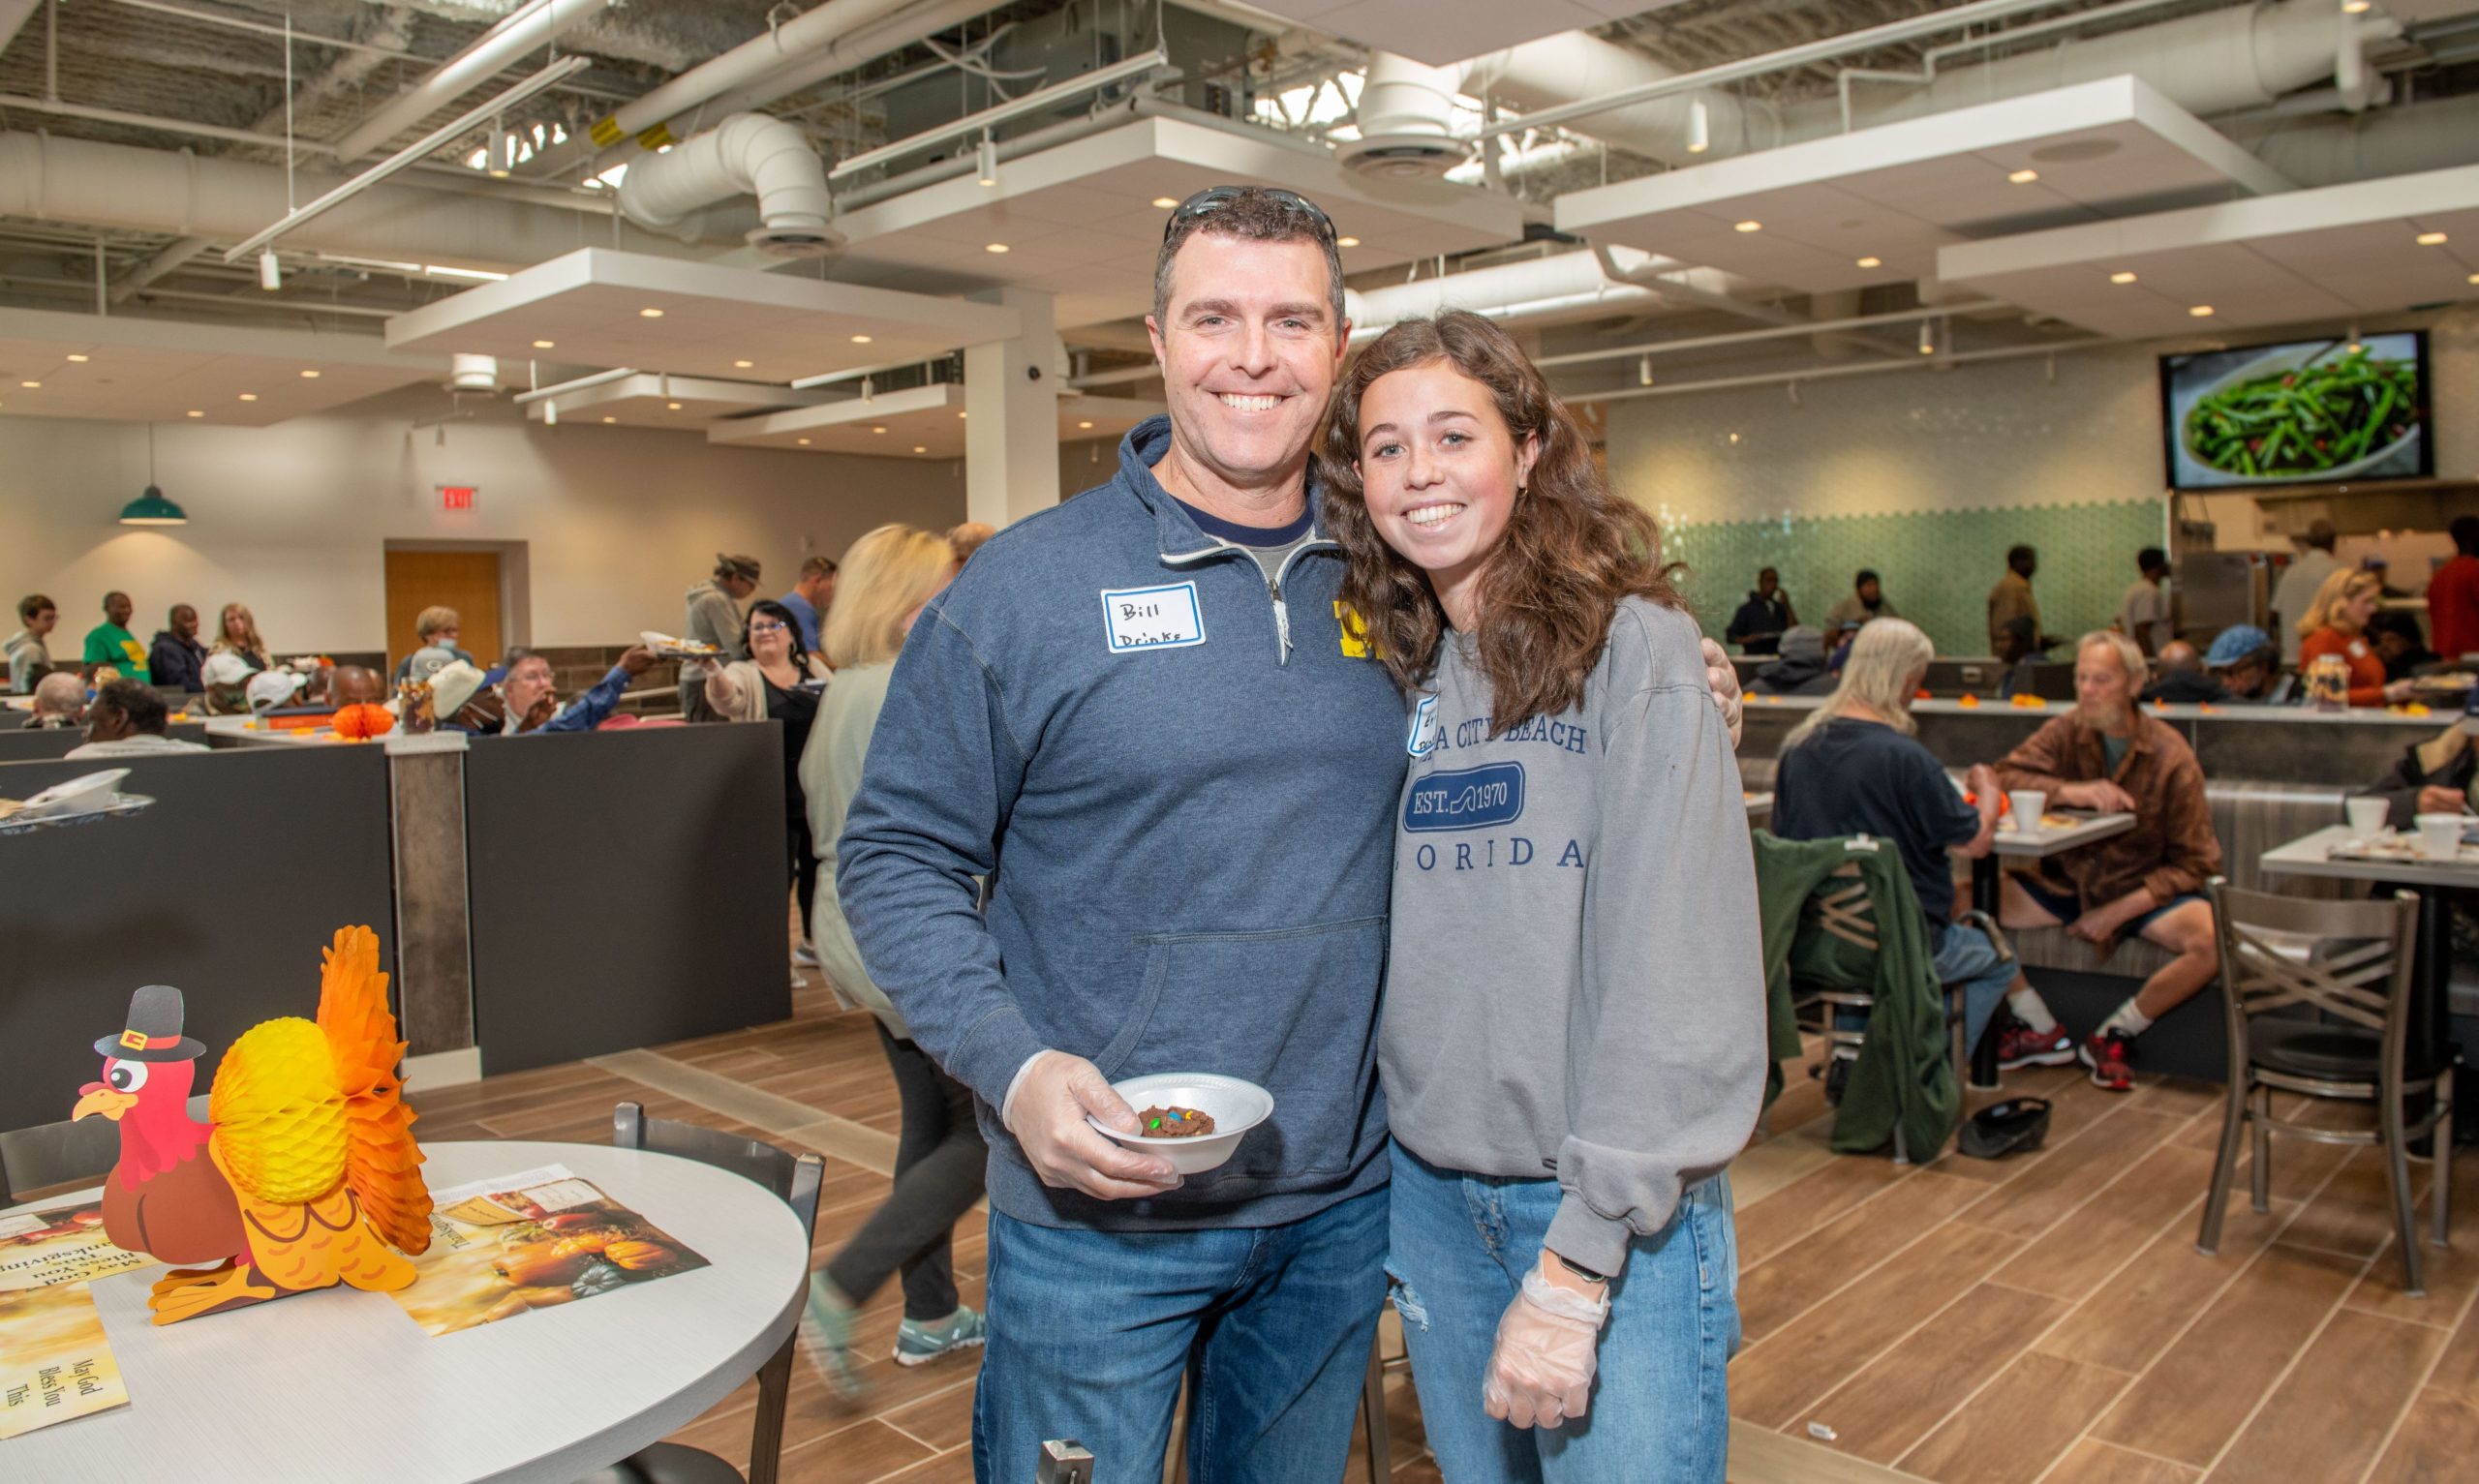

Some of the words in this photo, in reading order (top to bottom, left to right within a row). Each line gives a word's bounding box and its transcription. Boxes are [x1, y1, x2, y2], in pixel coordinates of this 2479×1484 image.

[444, 487, 473, 510] EXIT
[1119, 603, 1159, 621] Bill
[1504, 714, 1587, 754] BEACH
[1413, 791, 1449, 814] EST.
[1477, 782, 1508, 809] 1970
[1395, 837, 1584, 871] ORIDA
[39, 1366, 62, 1389] Bless
[77, 1376, 104, 1396] God
[7, 1383, 30, 1407] This
[44, 1386, 65, 1408] You
